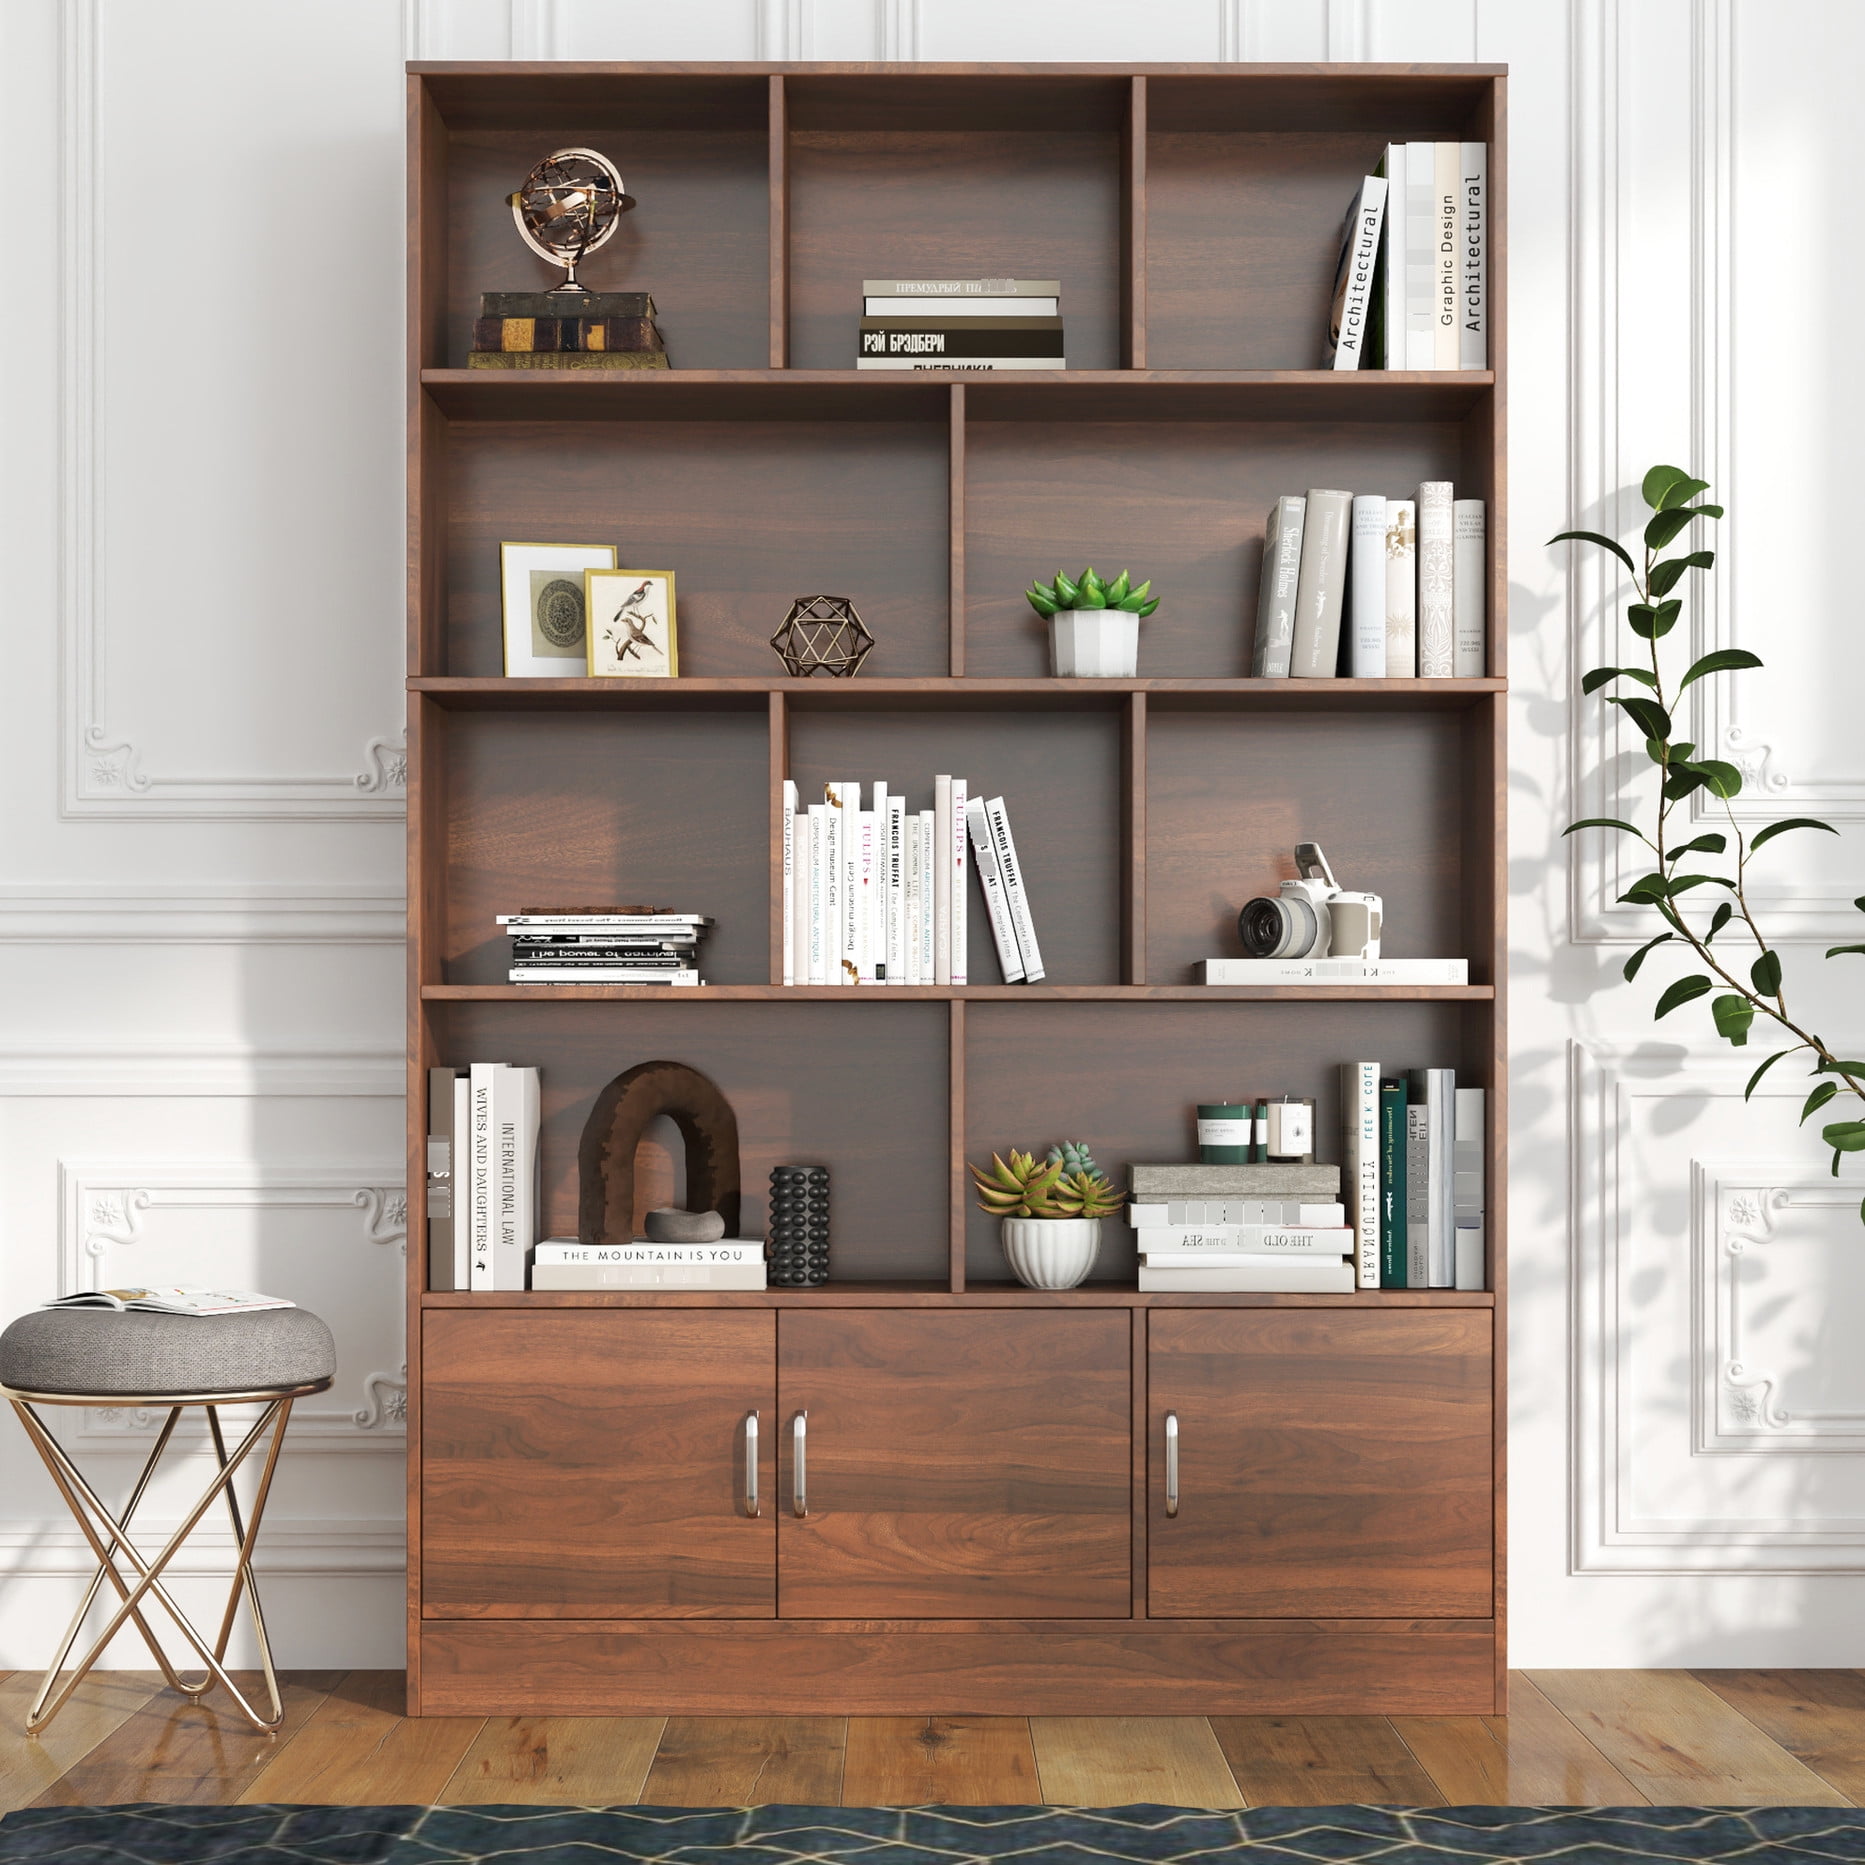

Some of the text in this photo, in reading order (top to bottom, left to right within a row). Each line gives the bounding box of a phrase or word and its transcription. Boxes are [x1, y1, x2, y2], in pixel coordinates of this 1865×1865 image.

[1342, 207, 1378, 350] Architectural
[1441, 195, 1456, 326] Graphic Design
[1465, 174, 1481, 332] Architectural
[864, 330, 945, 353] РЭЙ БРЭДБЕРИ
[1277, 526, 1300, 599] Sherlock Holmes
[784, 808, 792, 876] BAUHAUS
[827, 817, 837, 846] Design
[863, 824, 872, 873] TULIPS
[891, 809, 900, 850] FRANCOIS
[955, 793, 965, 853] TULIPS
[992, 811, 1009, 851] FRANCOIS
[1002, 852, 1018, 888] TRUFFAT
[829, 885, 837, 907] Gent
[846, 861, 855, 882] Gent
[891, 853, 900, 888] TRUFFAT
[845, 920, 855, 950] Design
[476, 1087, 488, 1252] WIVES AND DAUGHTERS
[502, 1122, 515, 1246] INTERNATIONAL LAW
[562, 1250, 743, 1261] THE MOUNTAIN IS YOU
